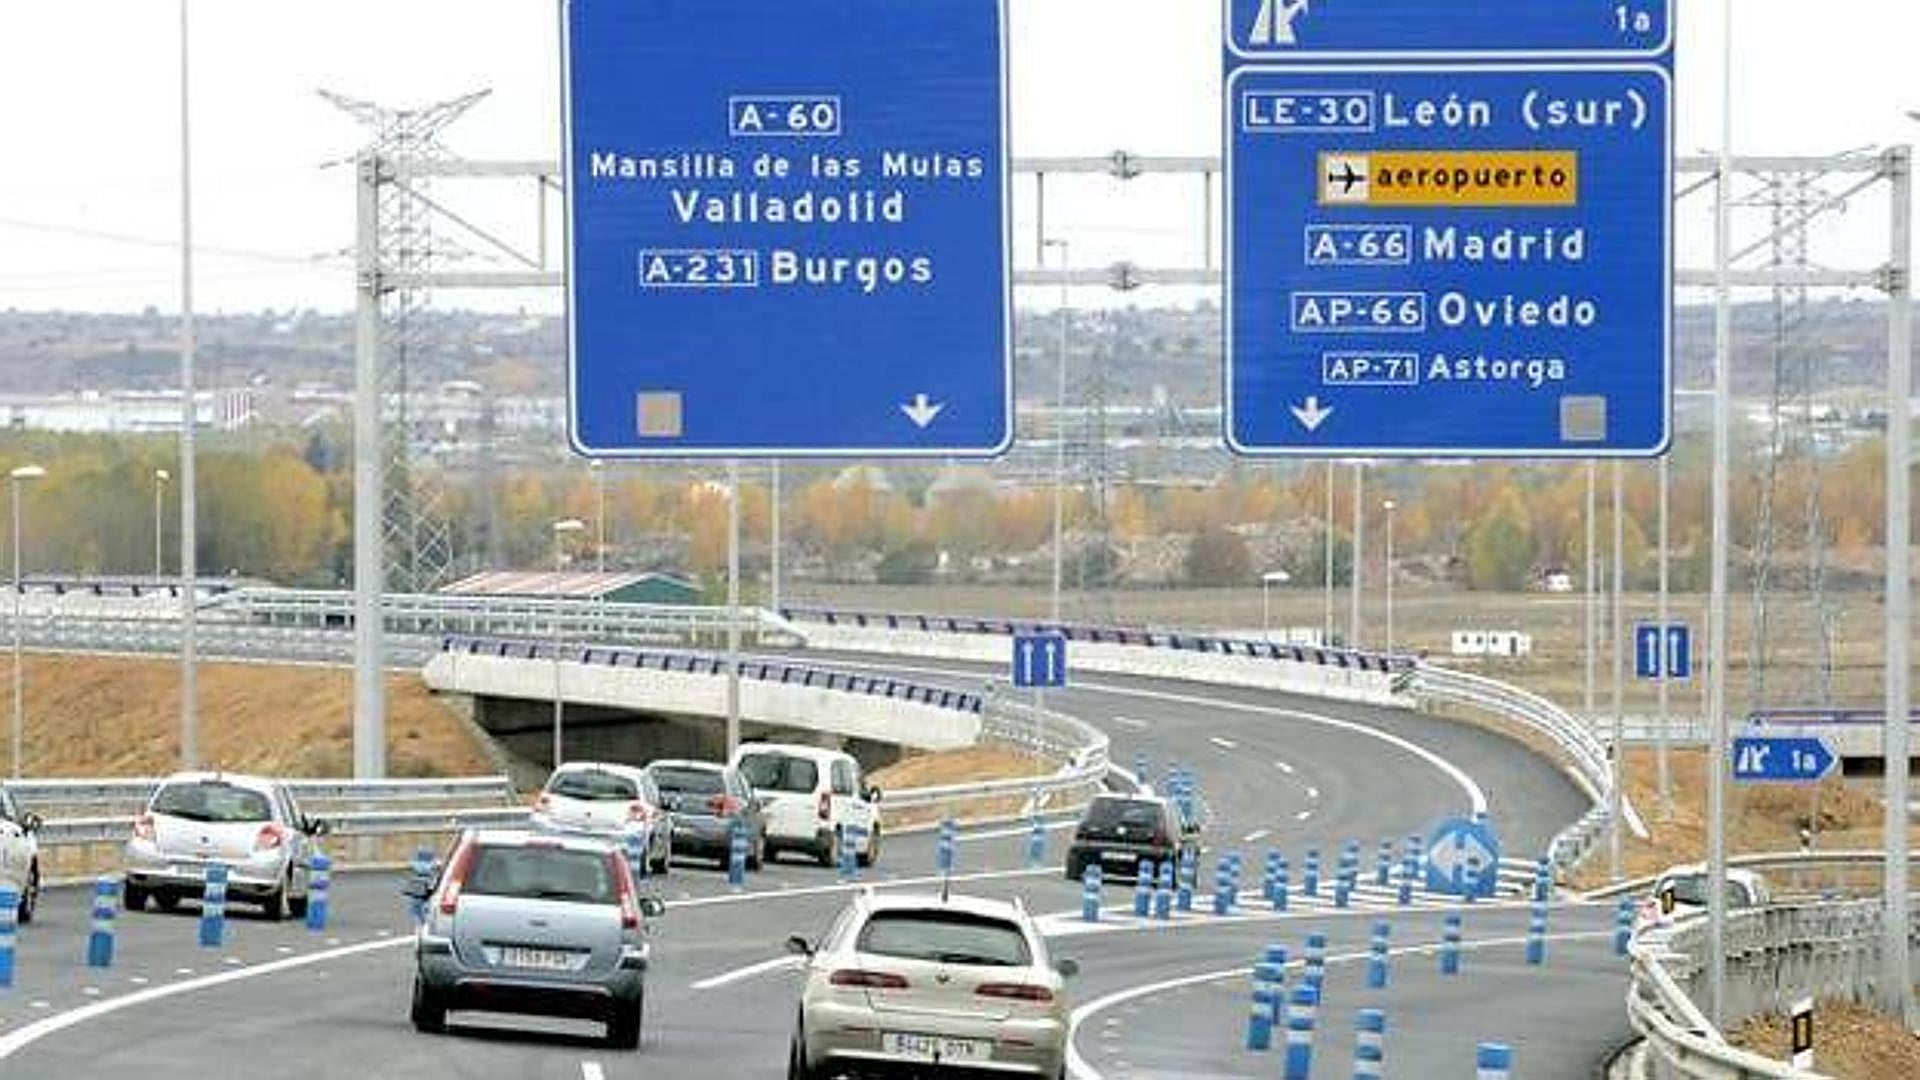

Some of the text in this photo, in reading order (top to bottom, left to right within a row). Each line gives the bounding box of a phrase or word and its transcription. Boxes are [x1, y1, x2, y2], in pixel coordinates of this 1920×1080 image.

[1617, 6, 1650, 31] 1a
[739, 103, 835, 130] A-60
[1249, 90, 1645, 129] LE-30 León (sur)
[592, 152, 982, 178] Mansilla de las Mulas
[1377, 166, 1567, 193] aeropuerto
[673, 190, 903, 222] Valladolid
[1313, 227, 1583, 260] A-66 Madrid
[645, 250, 931, 292] A-231 Burgos
[1300, 292, 1595, 326] AP-66 Oviedo
[1331, 354, 1564, 386] AP-71 Astorga
